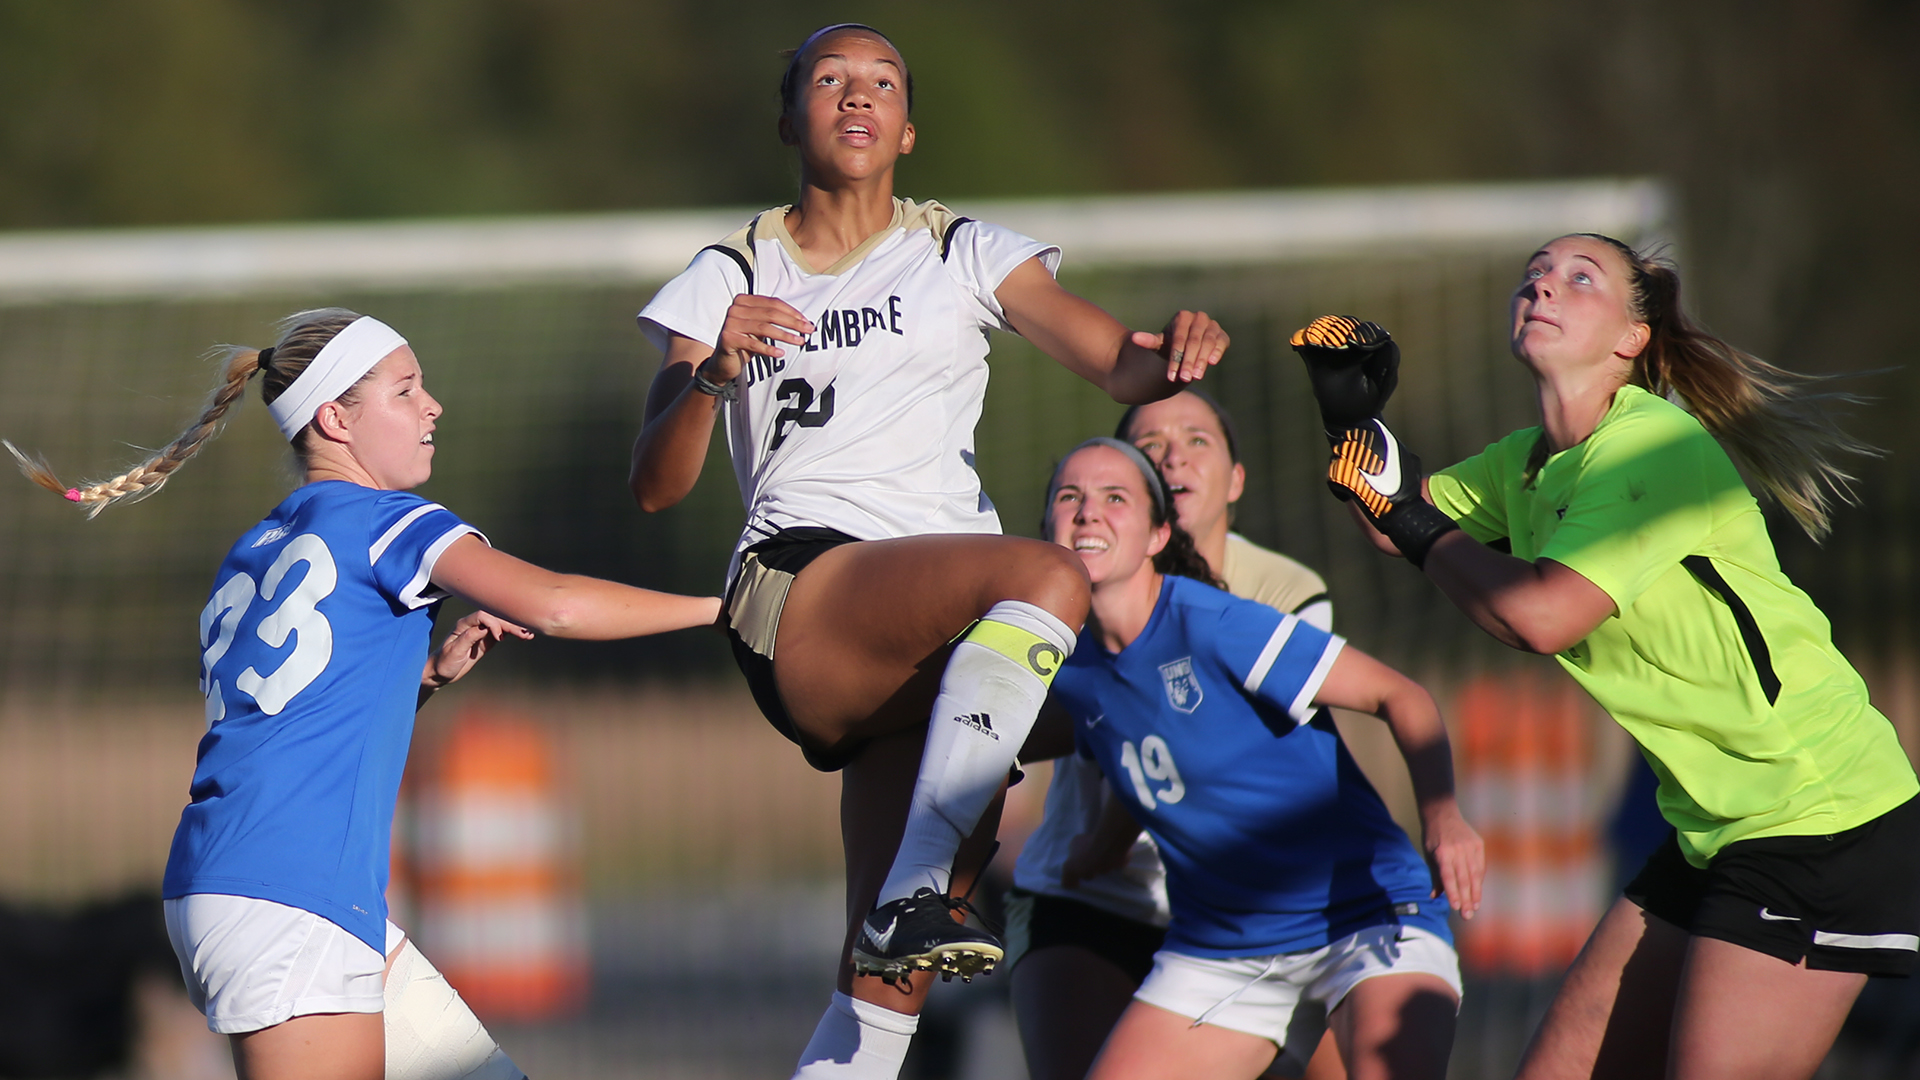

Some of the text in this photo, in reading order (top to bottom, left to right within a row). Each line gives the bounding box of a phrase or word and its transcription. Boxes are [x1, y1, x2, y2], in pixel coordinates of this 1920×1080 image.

[199, 532, 338, 732] 23
[1027, 642, 1060, 676] C
[953, 714, 1000, 741] adidas
[1120, 734, 1186, 811] 19
